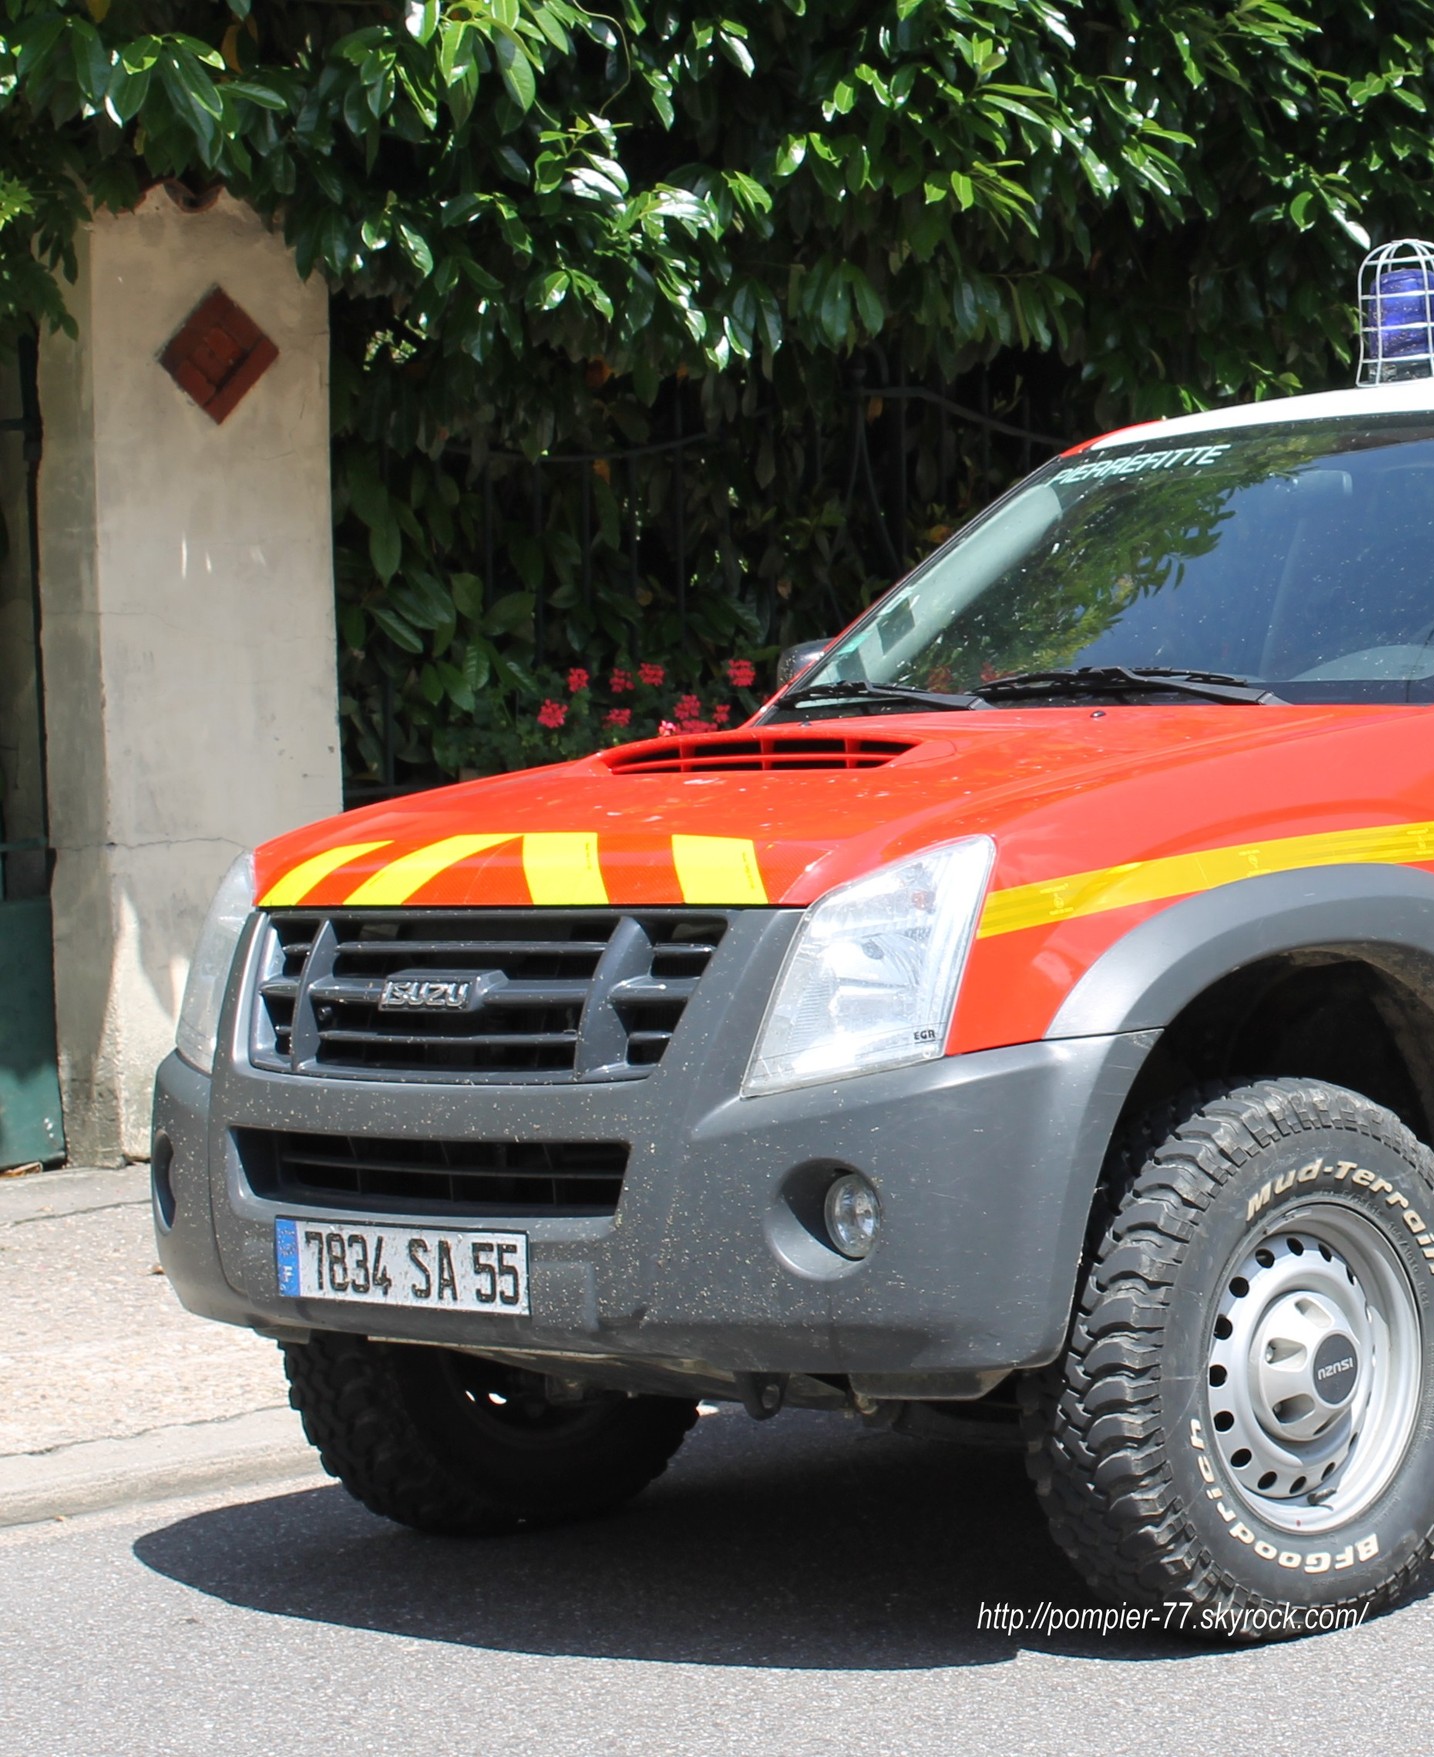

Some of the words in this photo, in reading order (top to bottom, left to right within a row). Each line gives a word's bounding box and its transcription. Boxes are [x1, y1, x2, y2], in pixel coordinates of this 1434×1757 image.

[381, 981, 470, 1007] ISUZU
[913, 1029, 935, 1040] EGR
[305, 1231, 392, 1296] 7834
[408, 1238, 458, 1301] SA
[471, 1242, 519, 1305] 55
[1317, 1356, 1354, 1381] ISUZU
[1190, 1418, 1379, 1575] BFGoodrich
